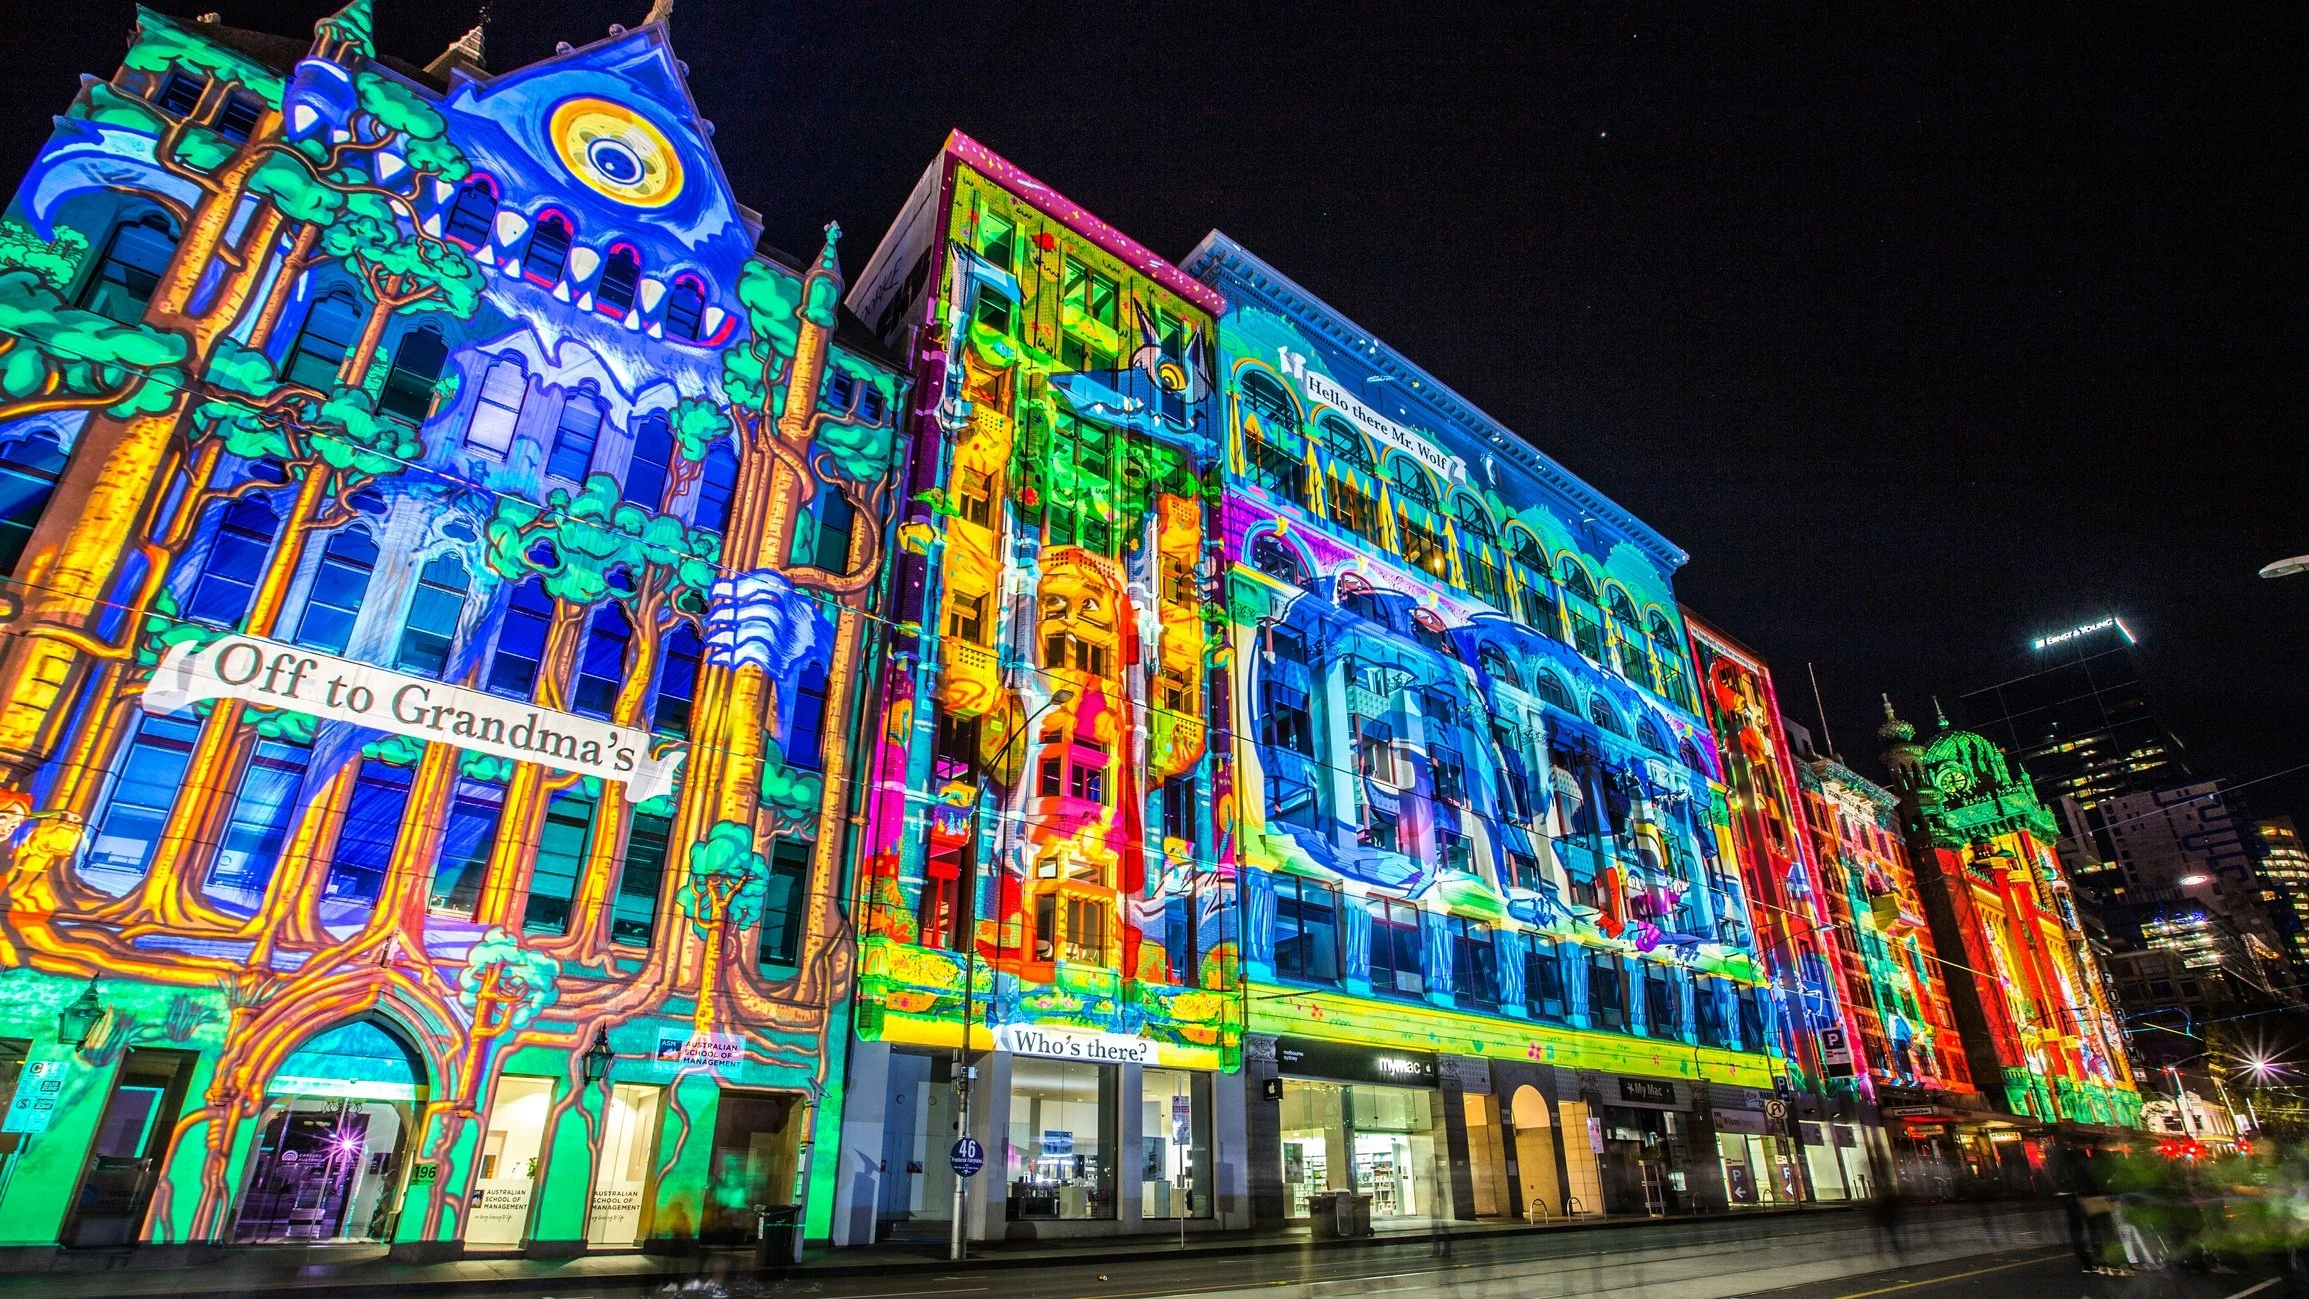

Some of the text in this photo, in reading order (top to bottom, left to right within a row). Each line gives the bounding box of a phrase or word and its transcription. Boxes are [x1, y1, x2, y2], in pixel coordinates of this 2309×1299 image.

[1308, 376, 1448, 471] Hello there Mr. Wolf
[2079, 618, 2113, 634] YOUNG
[213, 642, 636, 773] Off to Grandma's
[685, 1041, 738, 1051] AUSTRALIAN
[1014, 1030, 1147, 1061] Who's there?
[1827, 1033, 1838, 1046] P
[684, 1049, 719, 1057] SCHOOL
[683, 1057, 741, 1067] MANAGEMENT
[1379, 1058, 1421, 1075] mymac
[1634, 1082, 1663, 1098] My Mac
[1777, 1077, 1785, 1090] P
[959, 1140, 976, 1158] 46
[415, 1166, 437, 1178] 196
[1732, 1169, 1741, 1181] P
